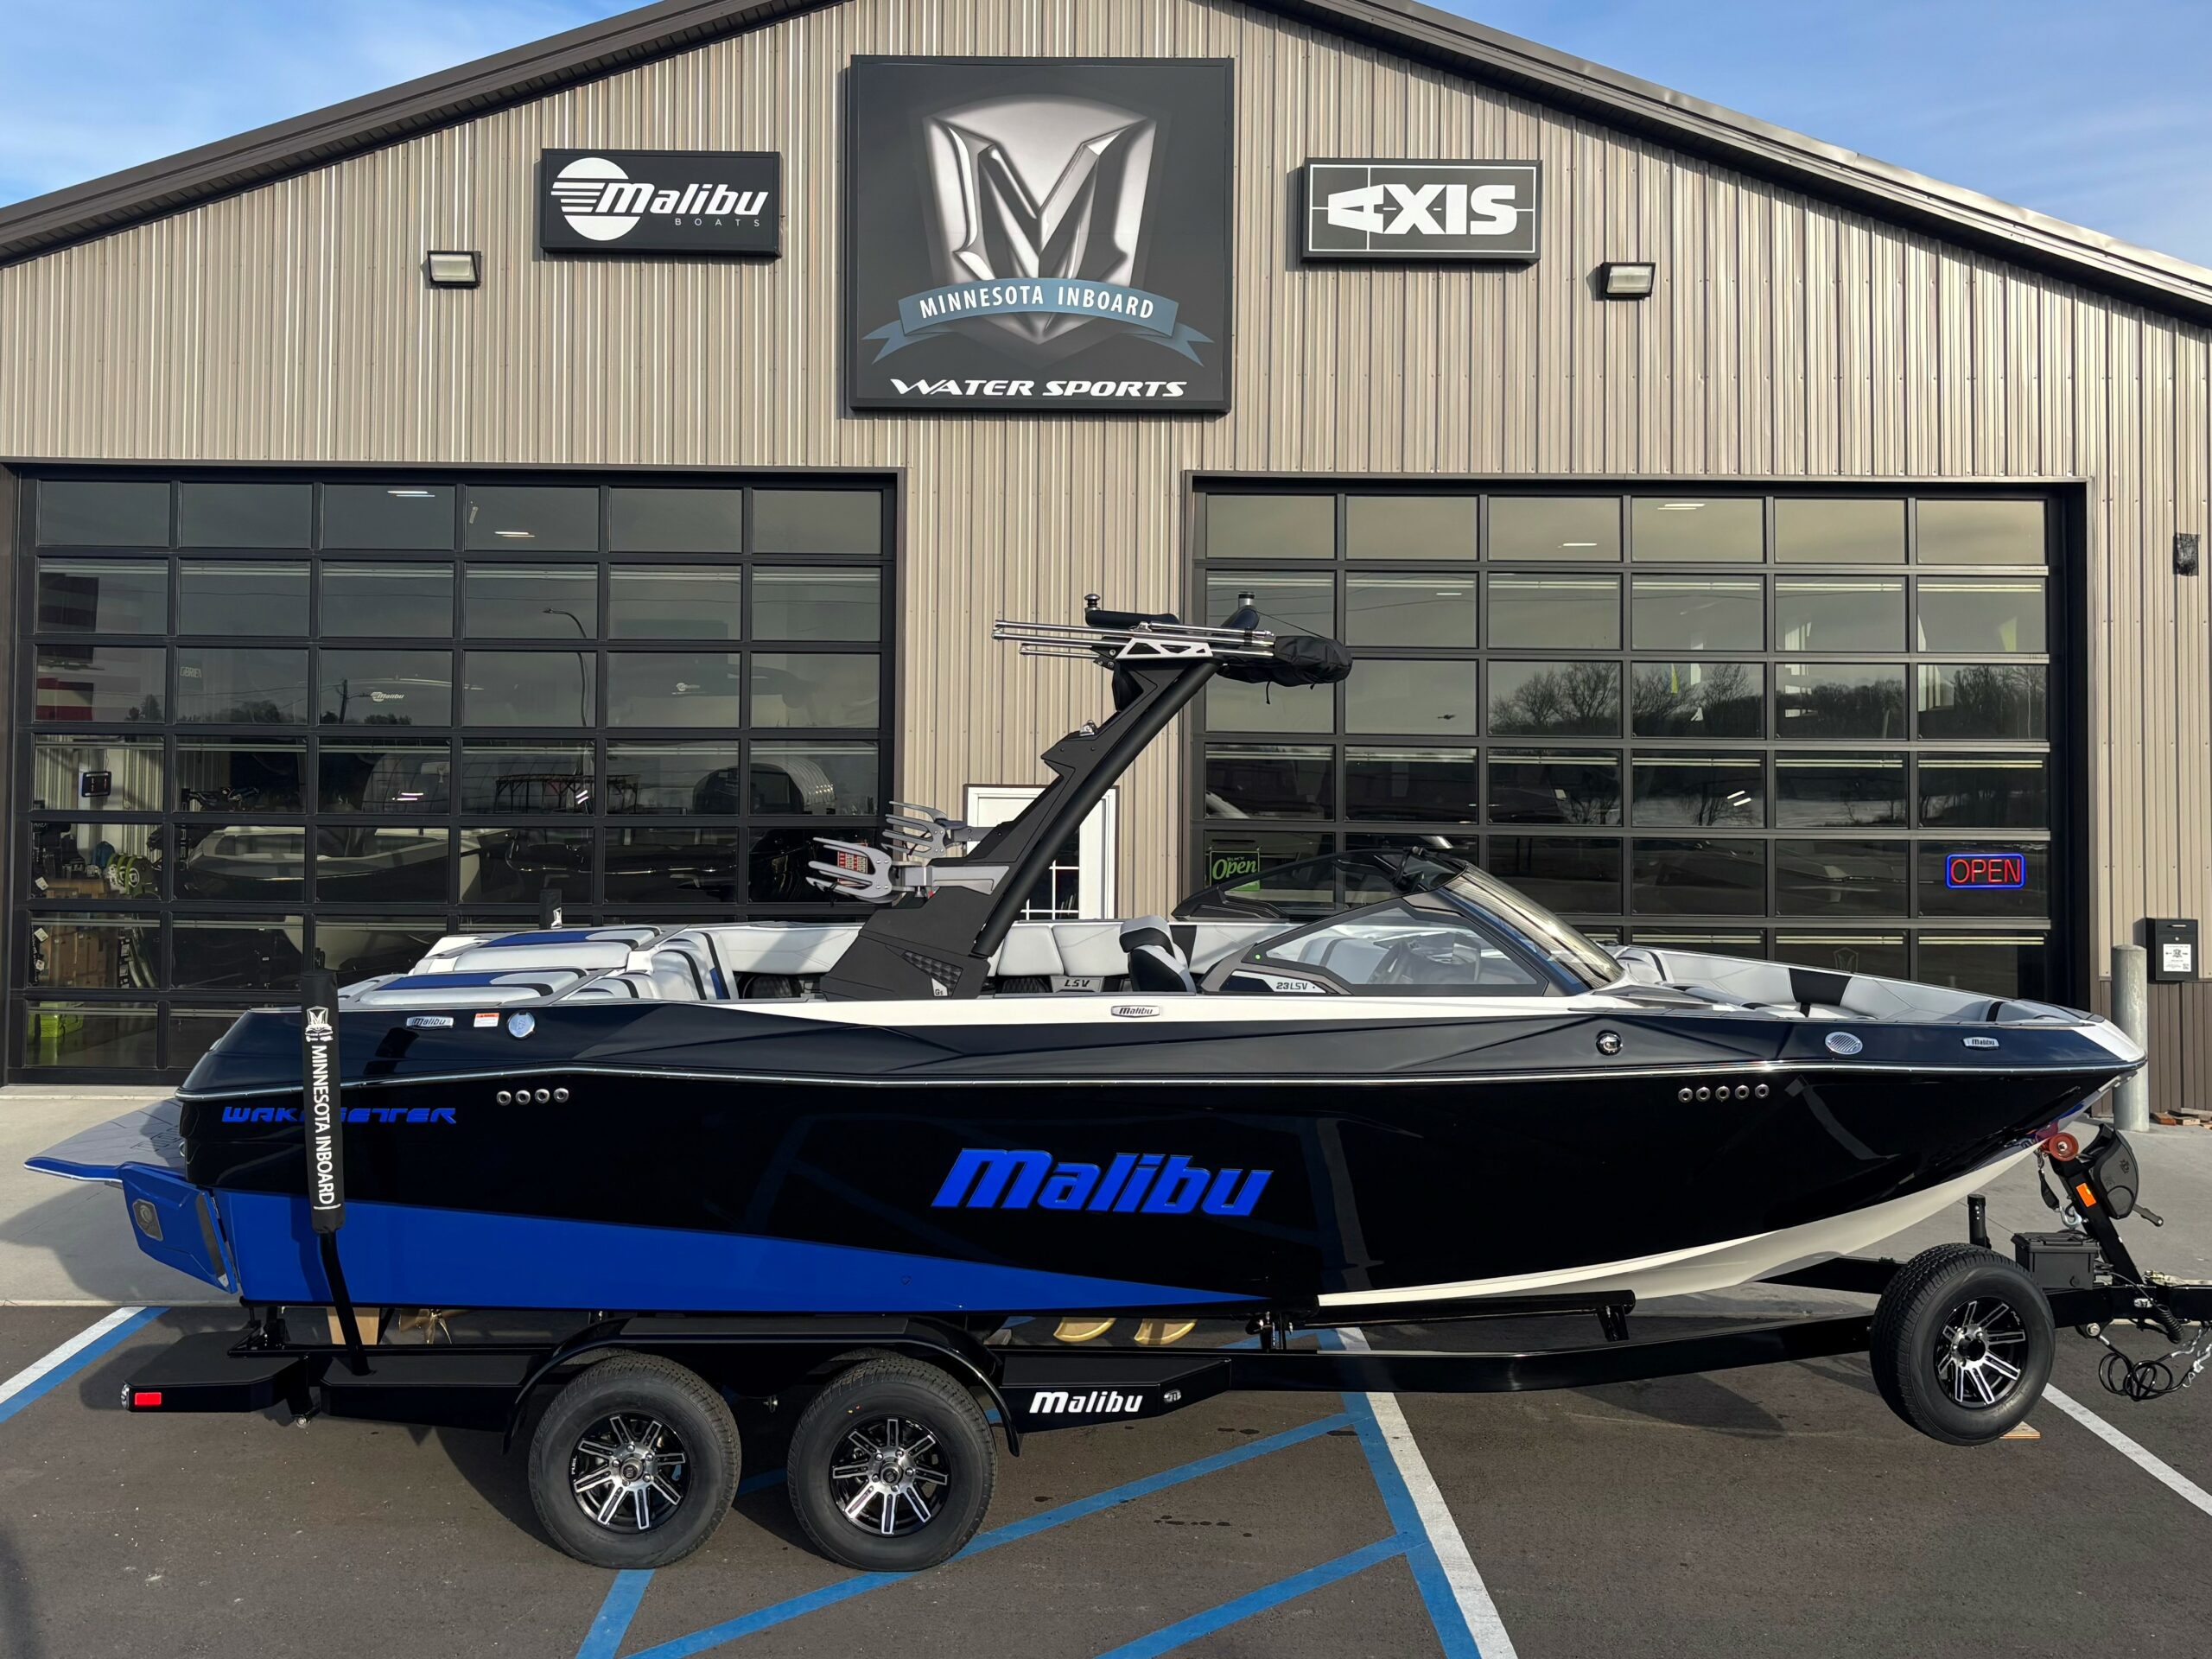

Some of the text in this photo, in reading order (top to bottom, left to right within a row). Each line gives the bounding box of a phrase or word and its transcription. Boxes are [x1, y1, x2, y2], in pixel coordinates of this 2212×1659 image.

[595, 183, 769, 215] Malibu
[1328, 184, 1517, 235] AXIS
[675, 218, 760, 227] BOATS
[919, 285, 1154, 319] MINNESOTA INBOARD
[890, 378, 1187, 397] WATER SPORTS
[1212, 859, 1257, 880] Open
[1950, 858, 2020, 883] OPEN
[1276, 982, 1308, 990] 23LSV
[1119, 1007, 1154, 1015] Malibu
[221, 1106, 456, 1124] WAKETTER
[311, 1045, 335, 1205] MINNESOTA INBOARD
[931, 1147, 1274, 1217] Malibu
[1028, 1390, 1143, 1414] Malibu
